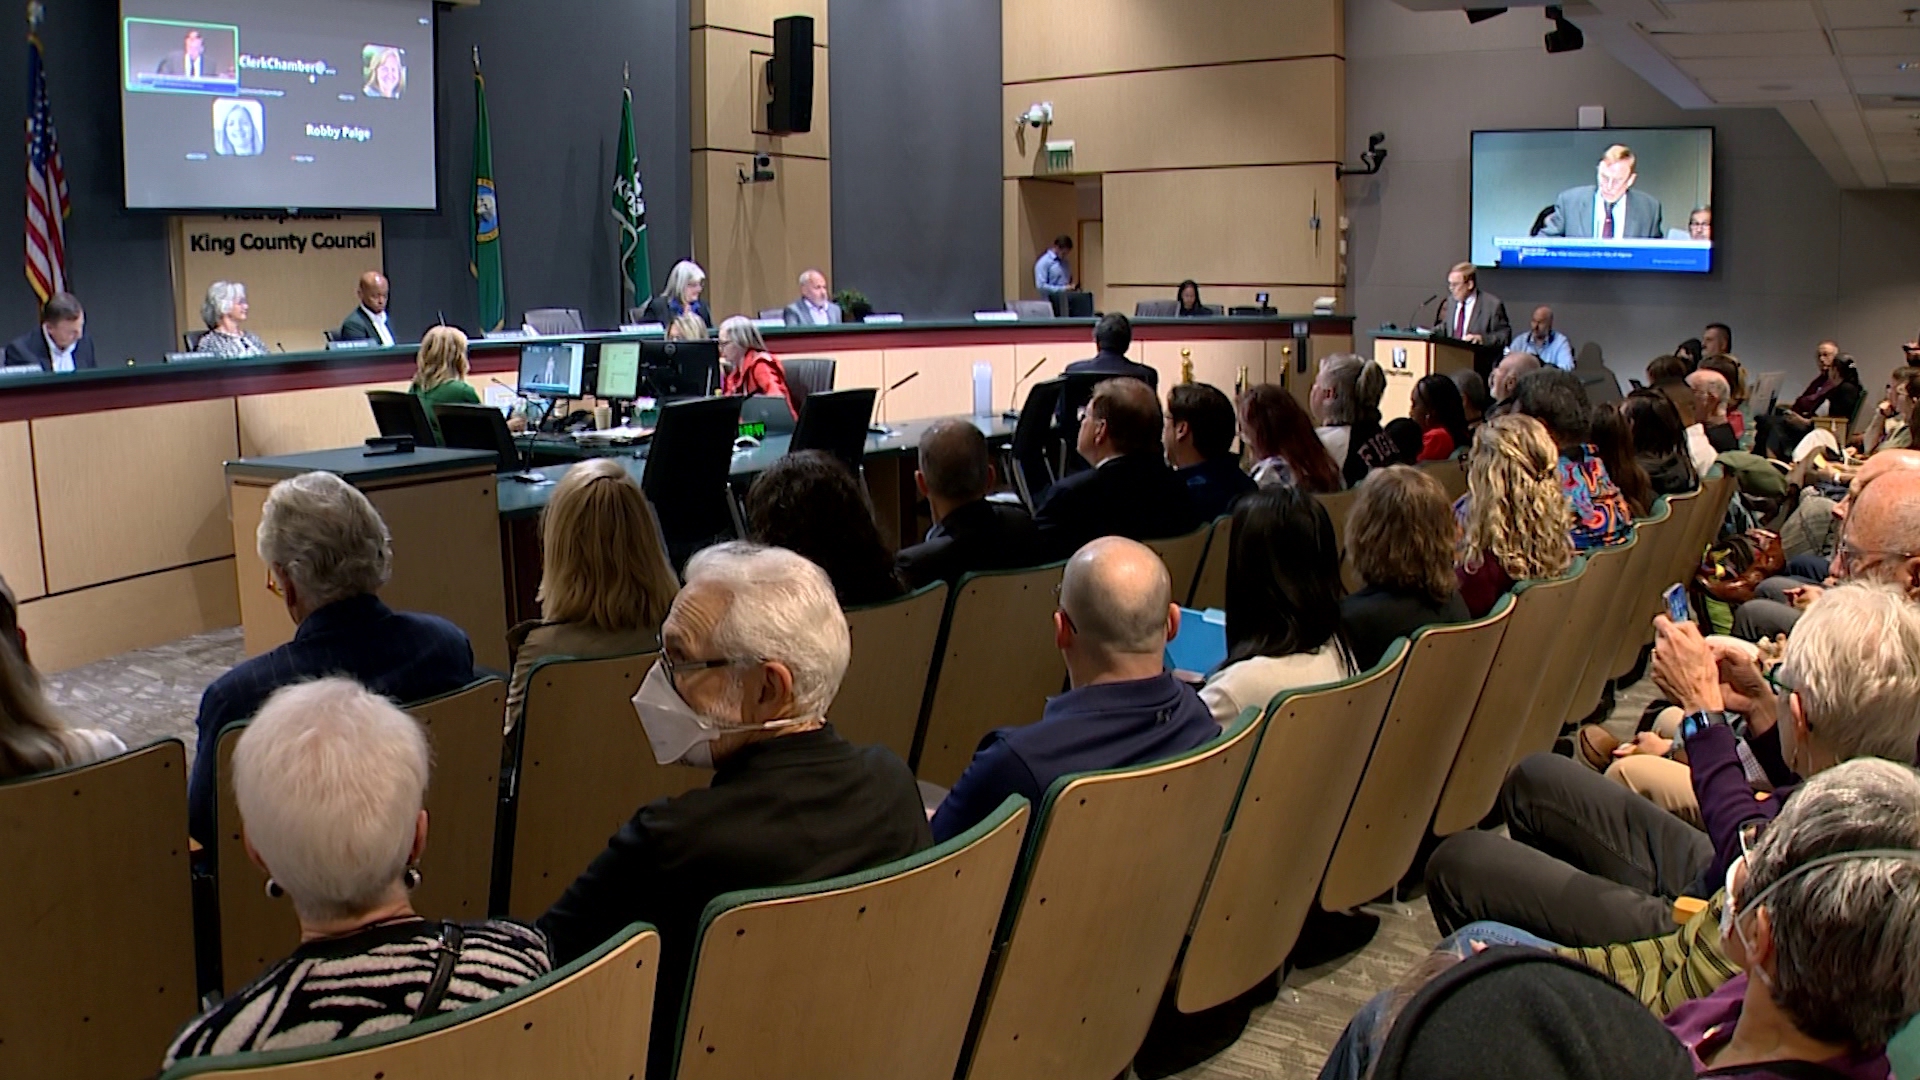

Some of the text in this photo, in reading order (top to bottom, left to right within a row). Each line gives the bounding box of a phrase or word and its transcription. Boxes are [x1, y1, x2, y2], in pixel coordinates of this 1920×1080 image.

[306, 124, 371, 142] Robby Paige
[190, 231, 376, 255] King County Council
